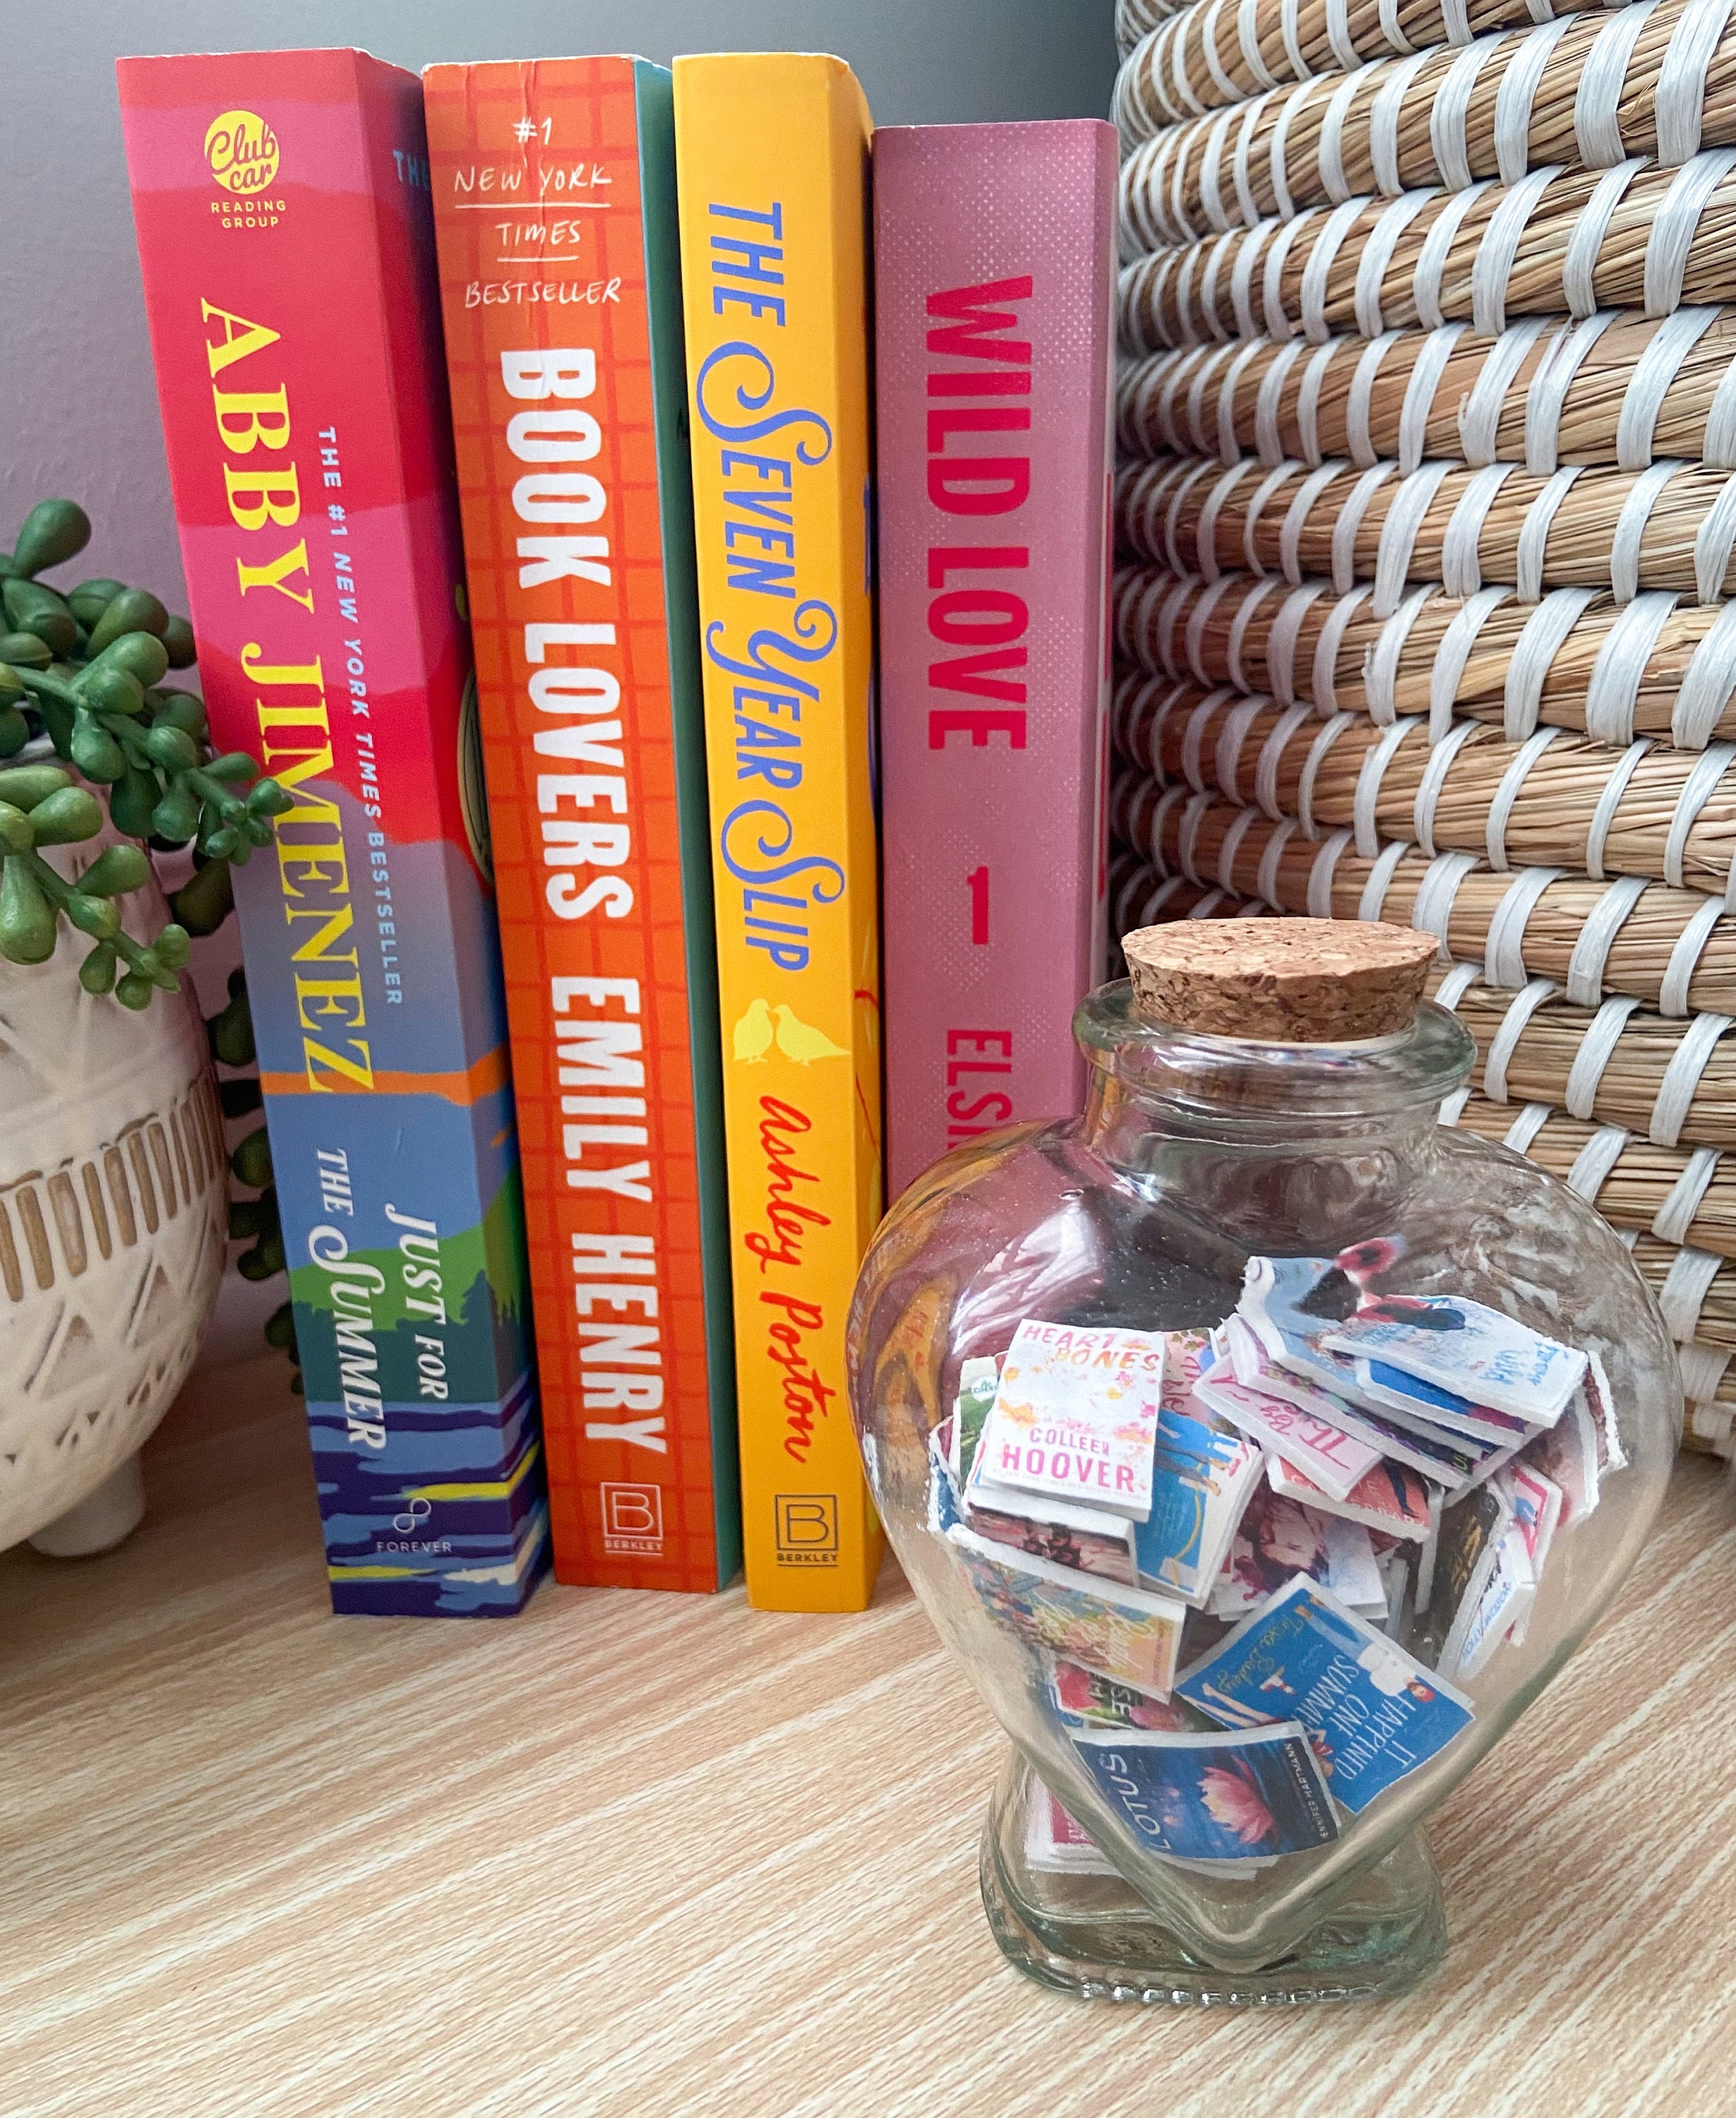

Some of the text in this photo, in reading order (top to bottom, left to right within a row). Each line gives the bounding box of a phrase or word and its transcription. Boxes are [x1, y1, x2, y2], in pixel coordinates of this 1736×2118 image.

[206, 124, 276, 175] Club
[513, 115, 553, 145] #1
[229, 163, 273, 191] car
[454, 163, 612, 196] NEW YORK
[211, 201, 287, 213] READING
[222, 217, 279, 228] GROUP
[495, 220, 581, 247] TIMES
[465, 277, 622, 309] BESTSELLER
[926, 275, 1034, 750] WILD LOVE
[696, 202, 845, 971] THE SEVEN YEAR SLIP
[200, 297, 374, 1092] ABBY JIMENEZ
[318, 426, 402, 1005] THE #1 NEW YORK TIMES BESTSELLER
[500, 348, 667, 1456] BOOK LOVERS EMILY HENRY
[966, 866, 989, 945] 1
[947, 1030, 1012, 1149] ELSI
[309, 1148, 387, 1450] THE SUMMER
[385, 1203, 448, 1400] JUST FOR
[1023, 1325, 1118, 1349] HEART
[1055, 1348, 1160, 1372] BONES
[1029, 1427, 1109, 1456] COLLEEN
[1002, 1444, 1135, 1492] HOOVER
[612, 1492, 654, 1531] B
[786, 1504, 829, 1542] B
[377, 1541, 452, 1552] FOREVER
[605, 1540, 663, 1551] BERKLEY
[777, 1553, 838, 1562] BERKLEY
[1329, 1694, 1370, 1737] ONE
[1334, 1694, 1416, 1780] HAPPENED
[1384, 1740, 1417, 1769] IT
[1284, 1742, 1312, 1798] HARTMANN
[1099, 1753, 1172, 1850] LOTUS
